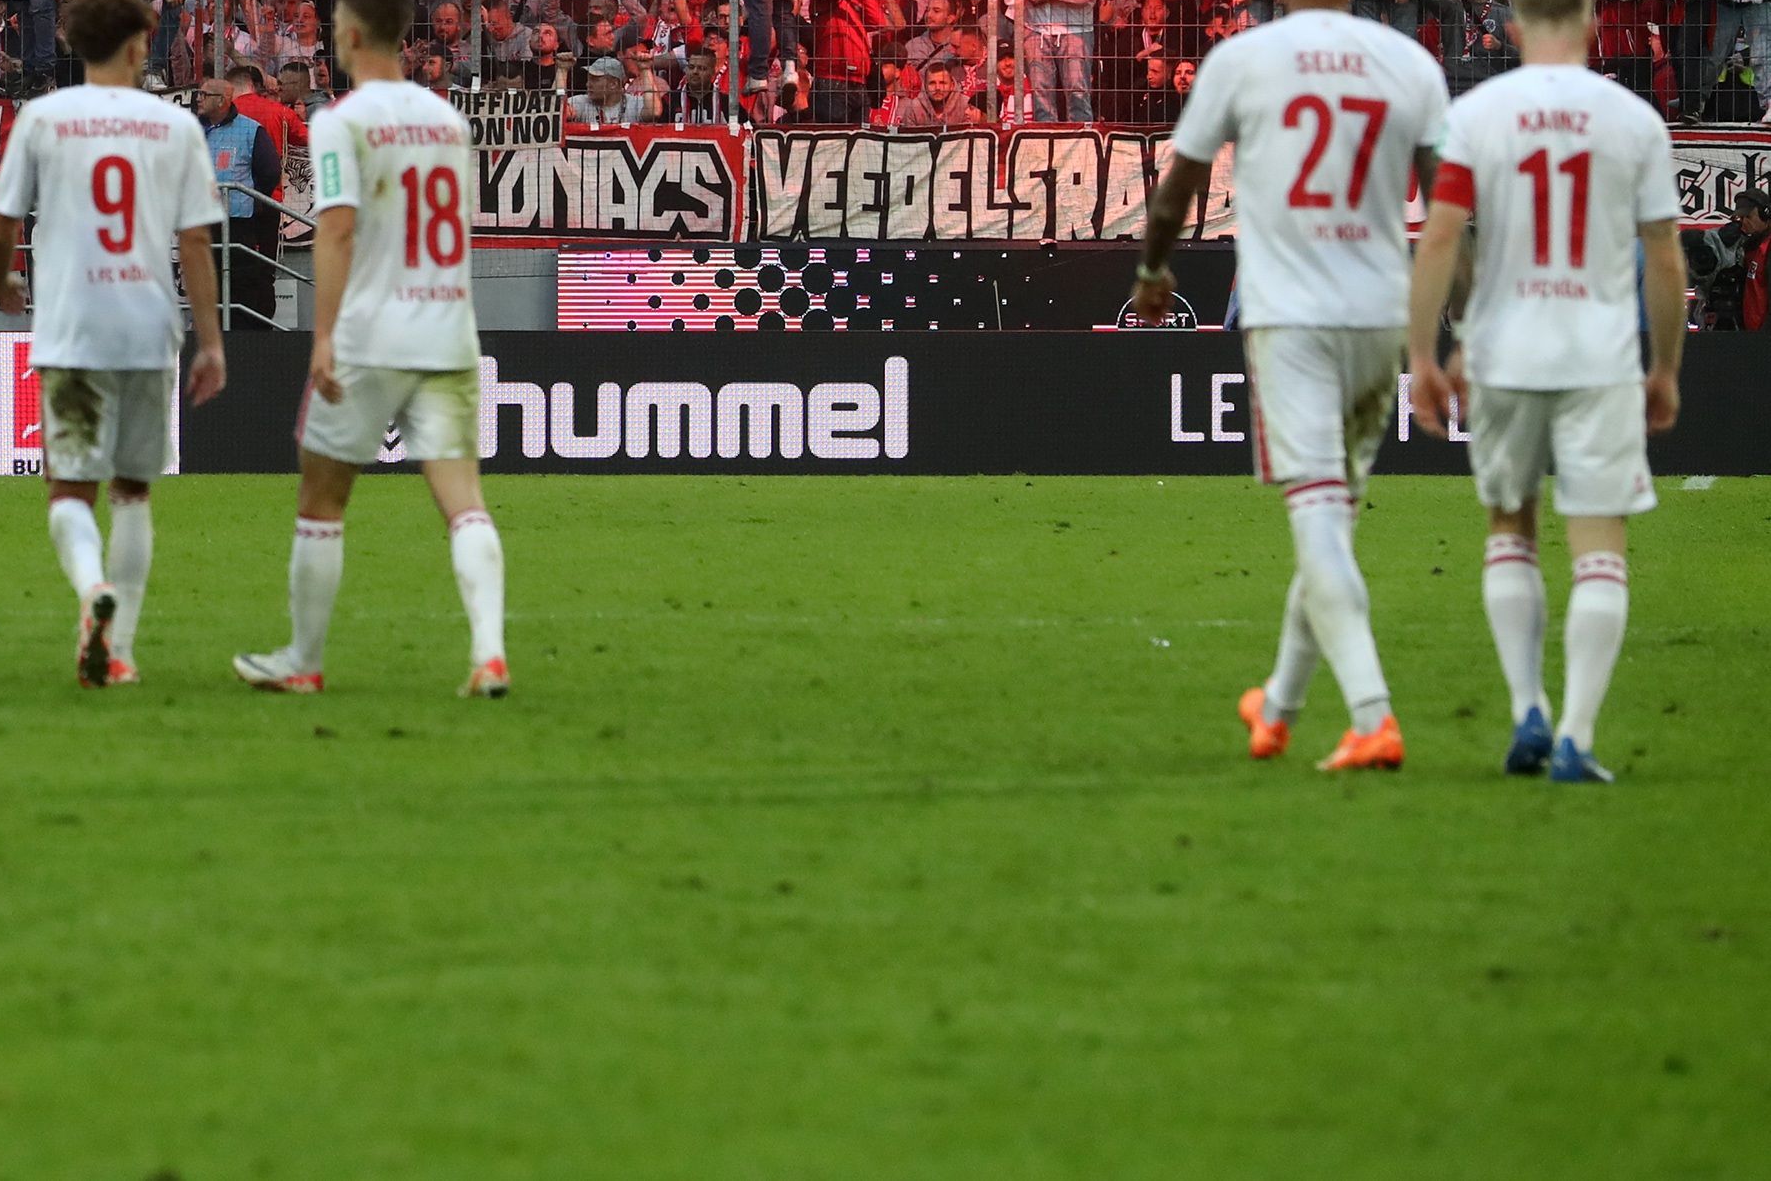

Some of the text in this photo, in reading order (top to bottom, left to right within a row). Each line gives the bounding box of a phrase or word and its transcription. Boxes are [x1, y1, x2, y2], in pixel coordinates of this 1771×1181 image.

[1296, 51, 1368, 76] SELKE
[54, 117, 170, 142] WALDSCHMIDT
[1282, 94, 1389, 210] 27
[1517, 110, 1590, 134] KAINZ
[91, 153, 136, 254] 9
[400, 165, 466, 268] 18
[472, 149, 726, 231] LONIACS
[1517, 147, 1592, 268] 11
[477, 355, 910, 460] hummel
